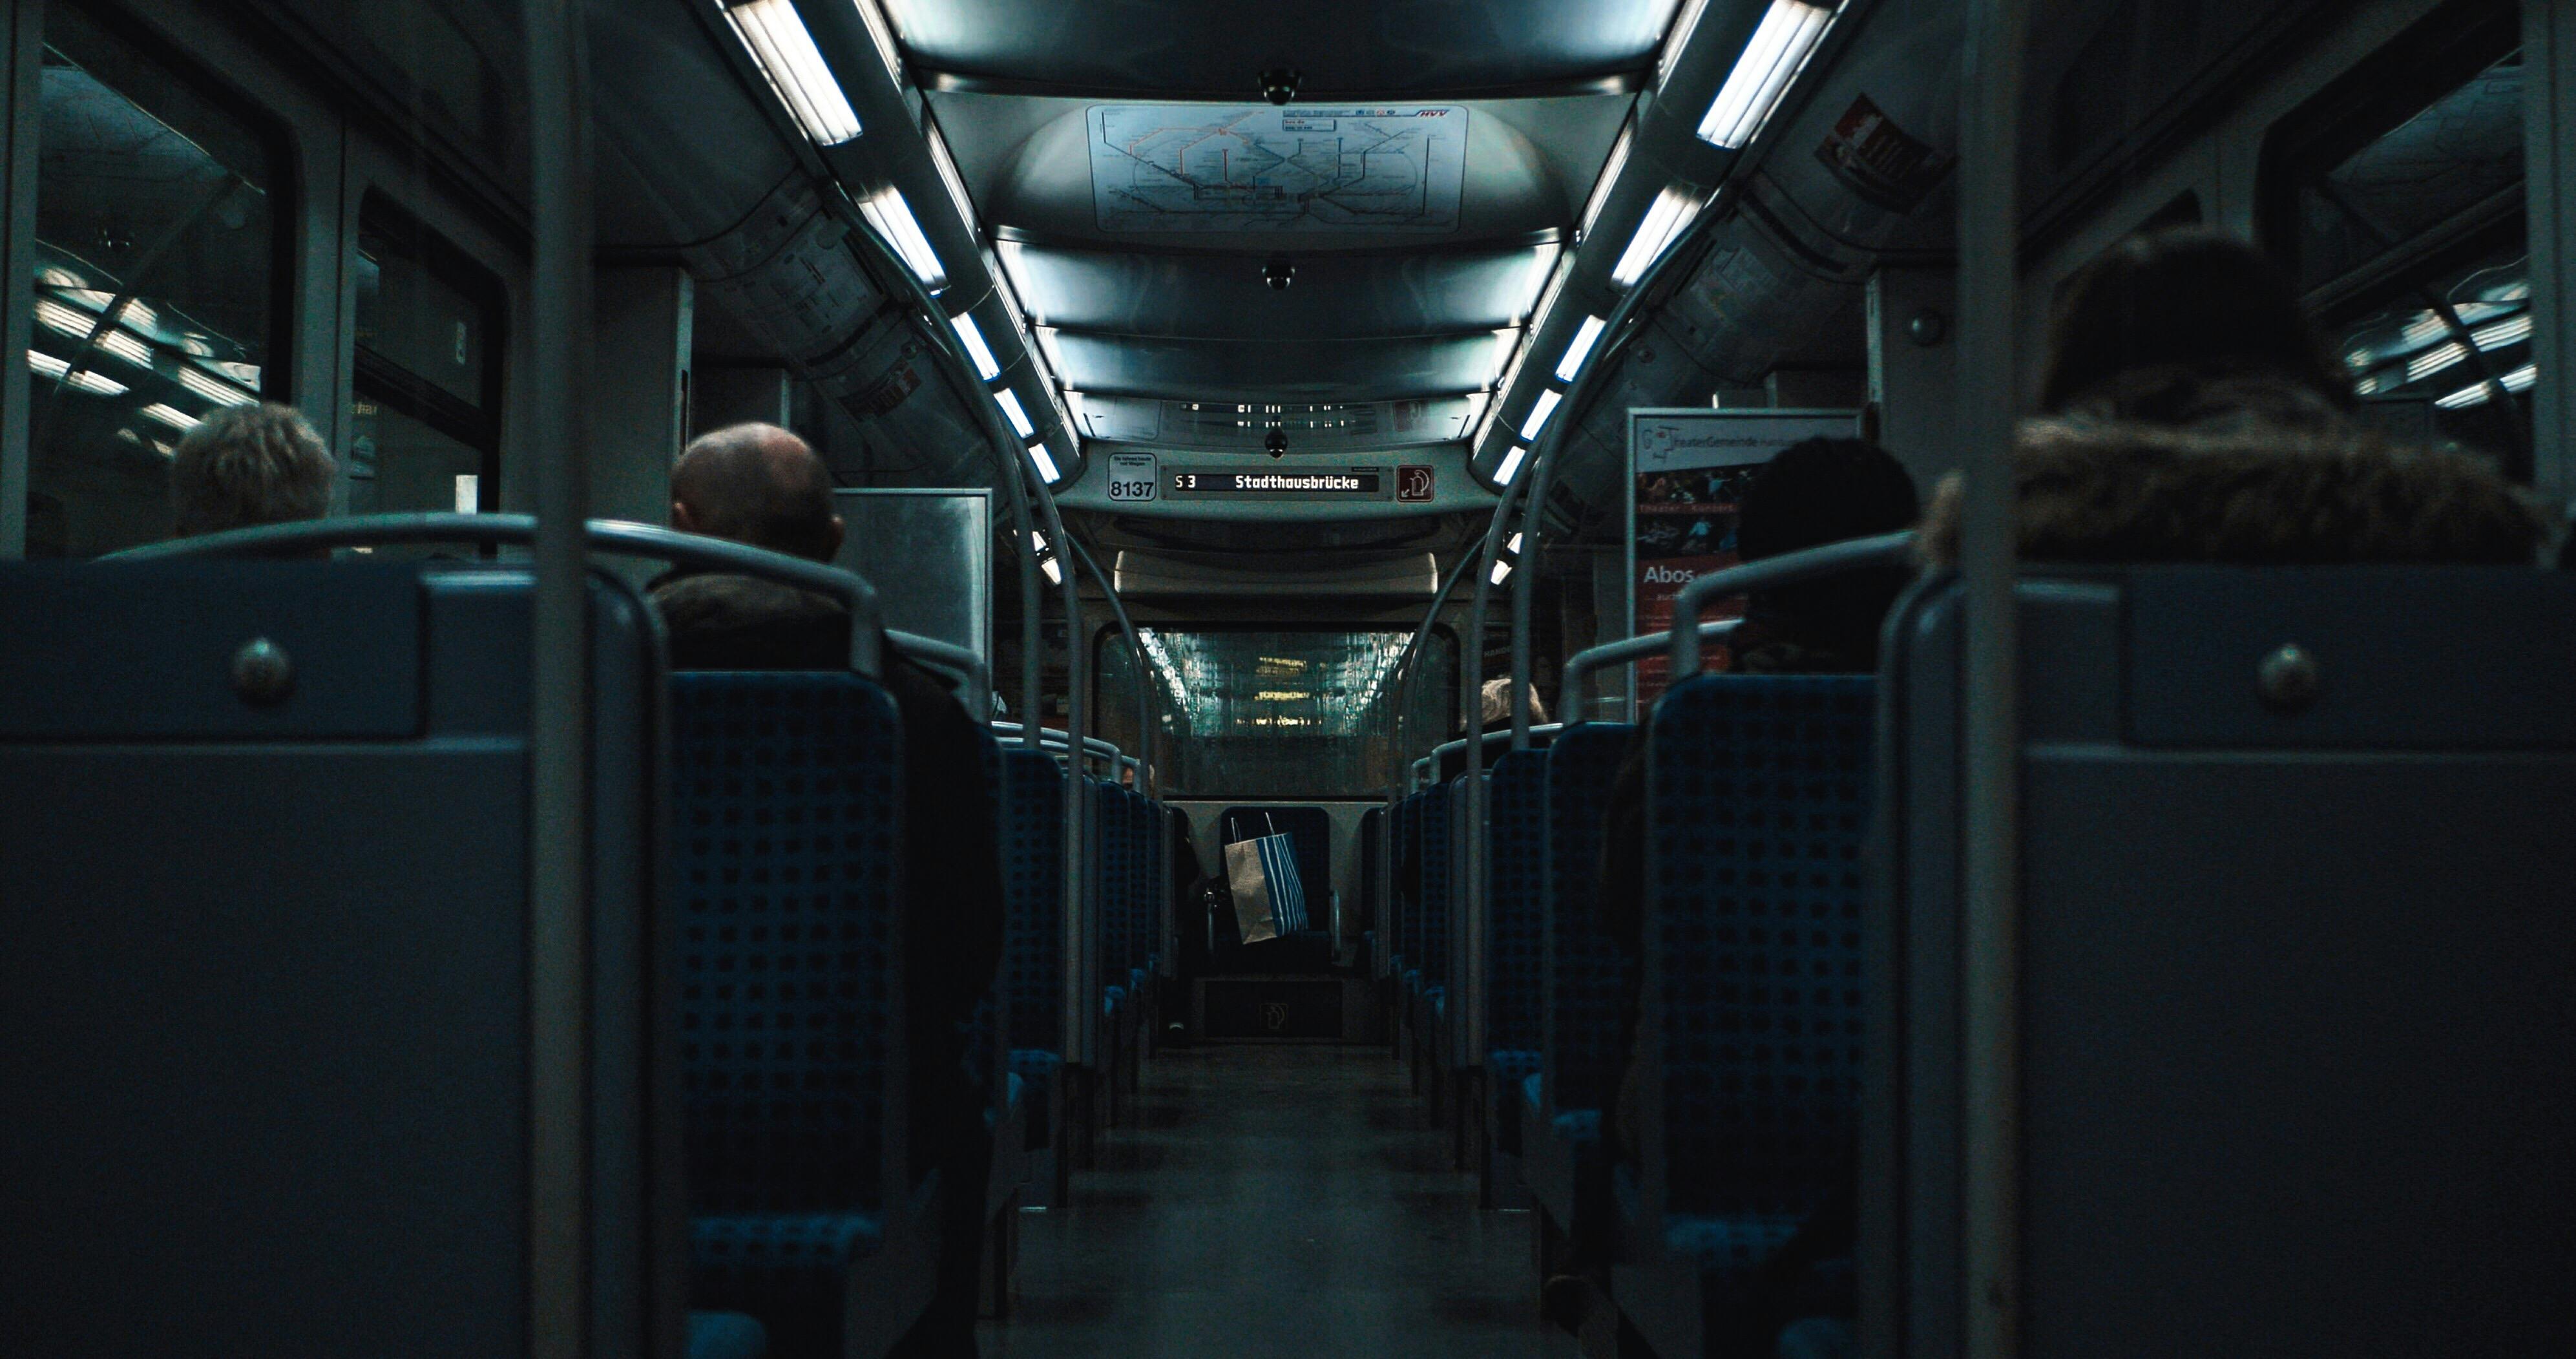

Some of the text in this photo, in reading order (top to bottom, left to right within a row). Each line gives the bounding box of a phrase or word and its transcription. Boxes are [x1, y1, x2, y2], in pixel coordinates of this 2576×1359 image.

[1111, 481, 1154, 497] 8137
[1175, 475, 1359, 490] S 3 Stadthausbrücke
[1643, 565, 1695, 584] Abos
